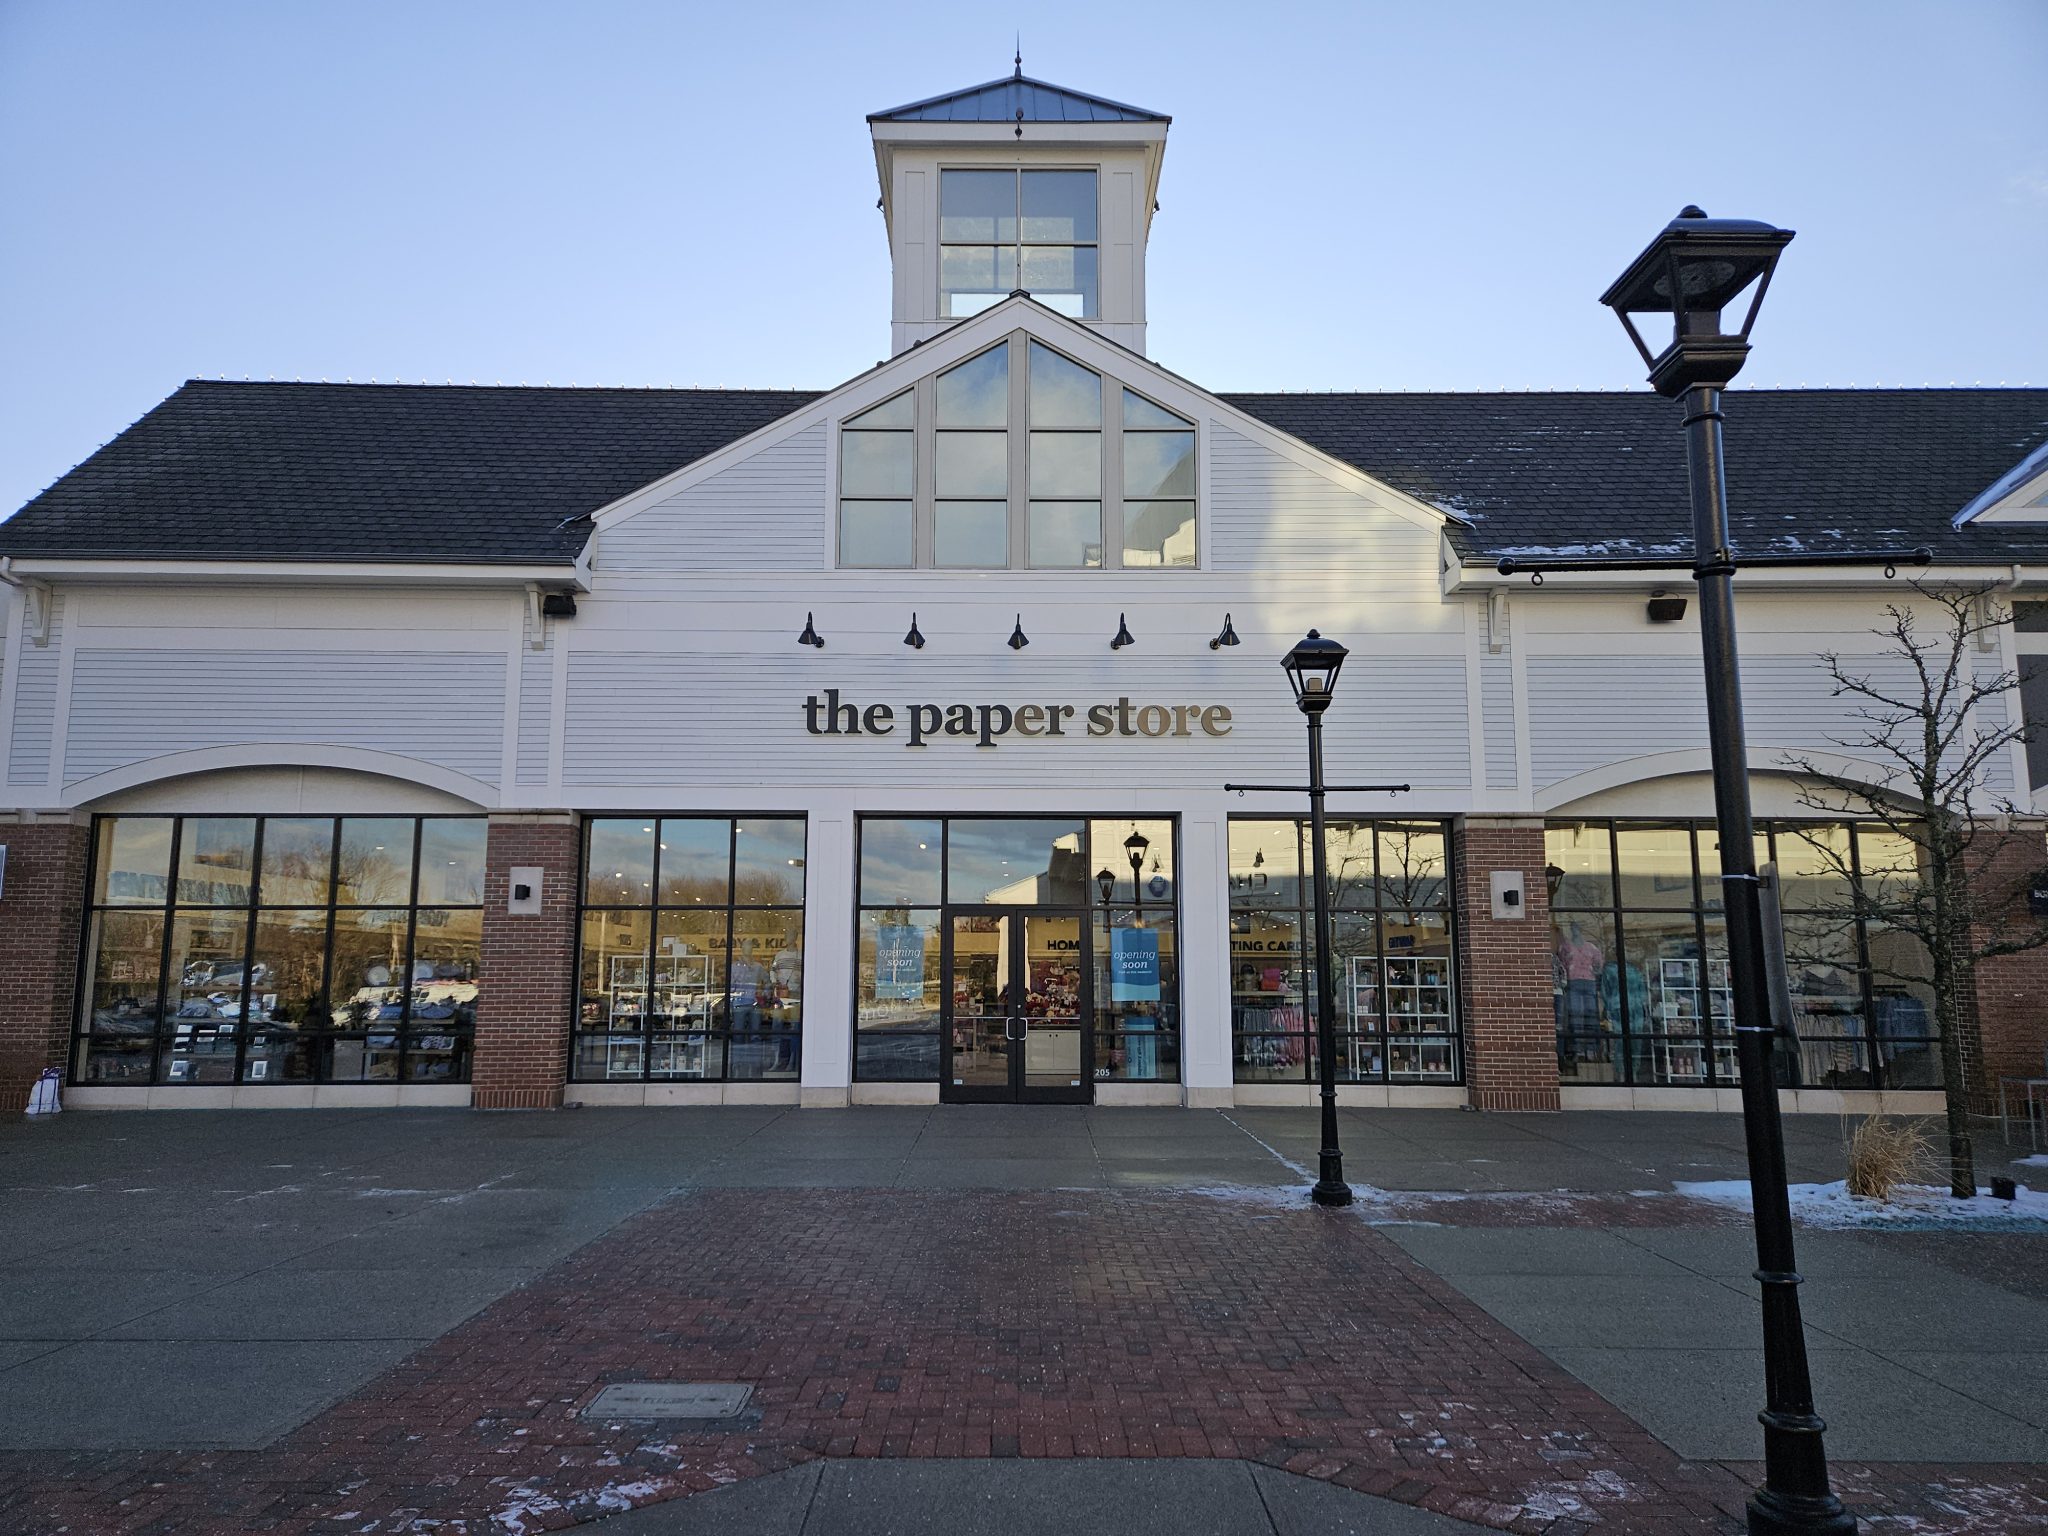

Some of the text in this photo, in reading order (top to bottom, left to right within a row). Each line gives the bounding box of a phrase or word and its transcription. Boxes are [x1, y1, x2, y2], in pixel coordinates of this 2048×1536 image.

[802, 688, 1233, 747] the paper store
[1047, 939, 1080, 951] HOM
[879, 947, 921, 959] opening
[1113, 950, 1156, 961] opening
[886, 959, 912, 967] soon
[1122, 961, 1148, 969] soon
[1095, 1068, 1110, 1077] 205
